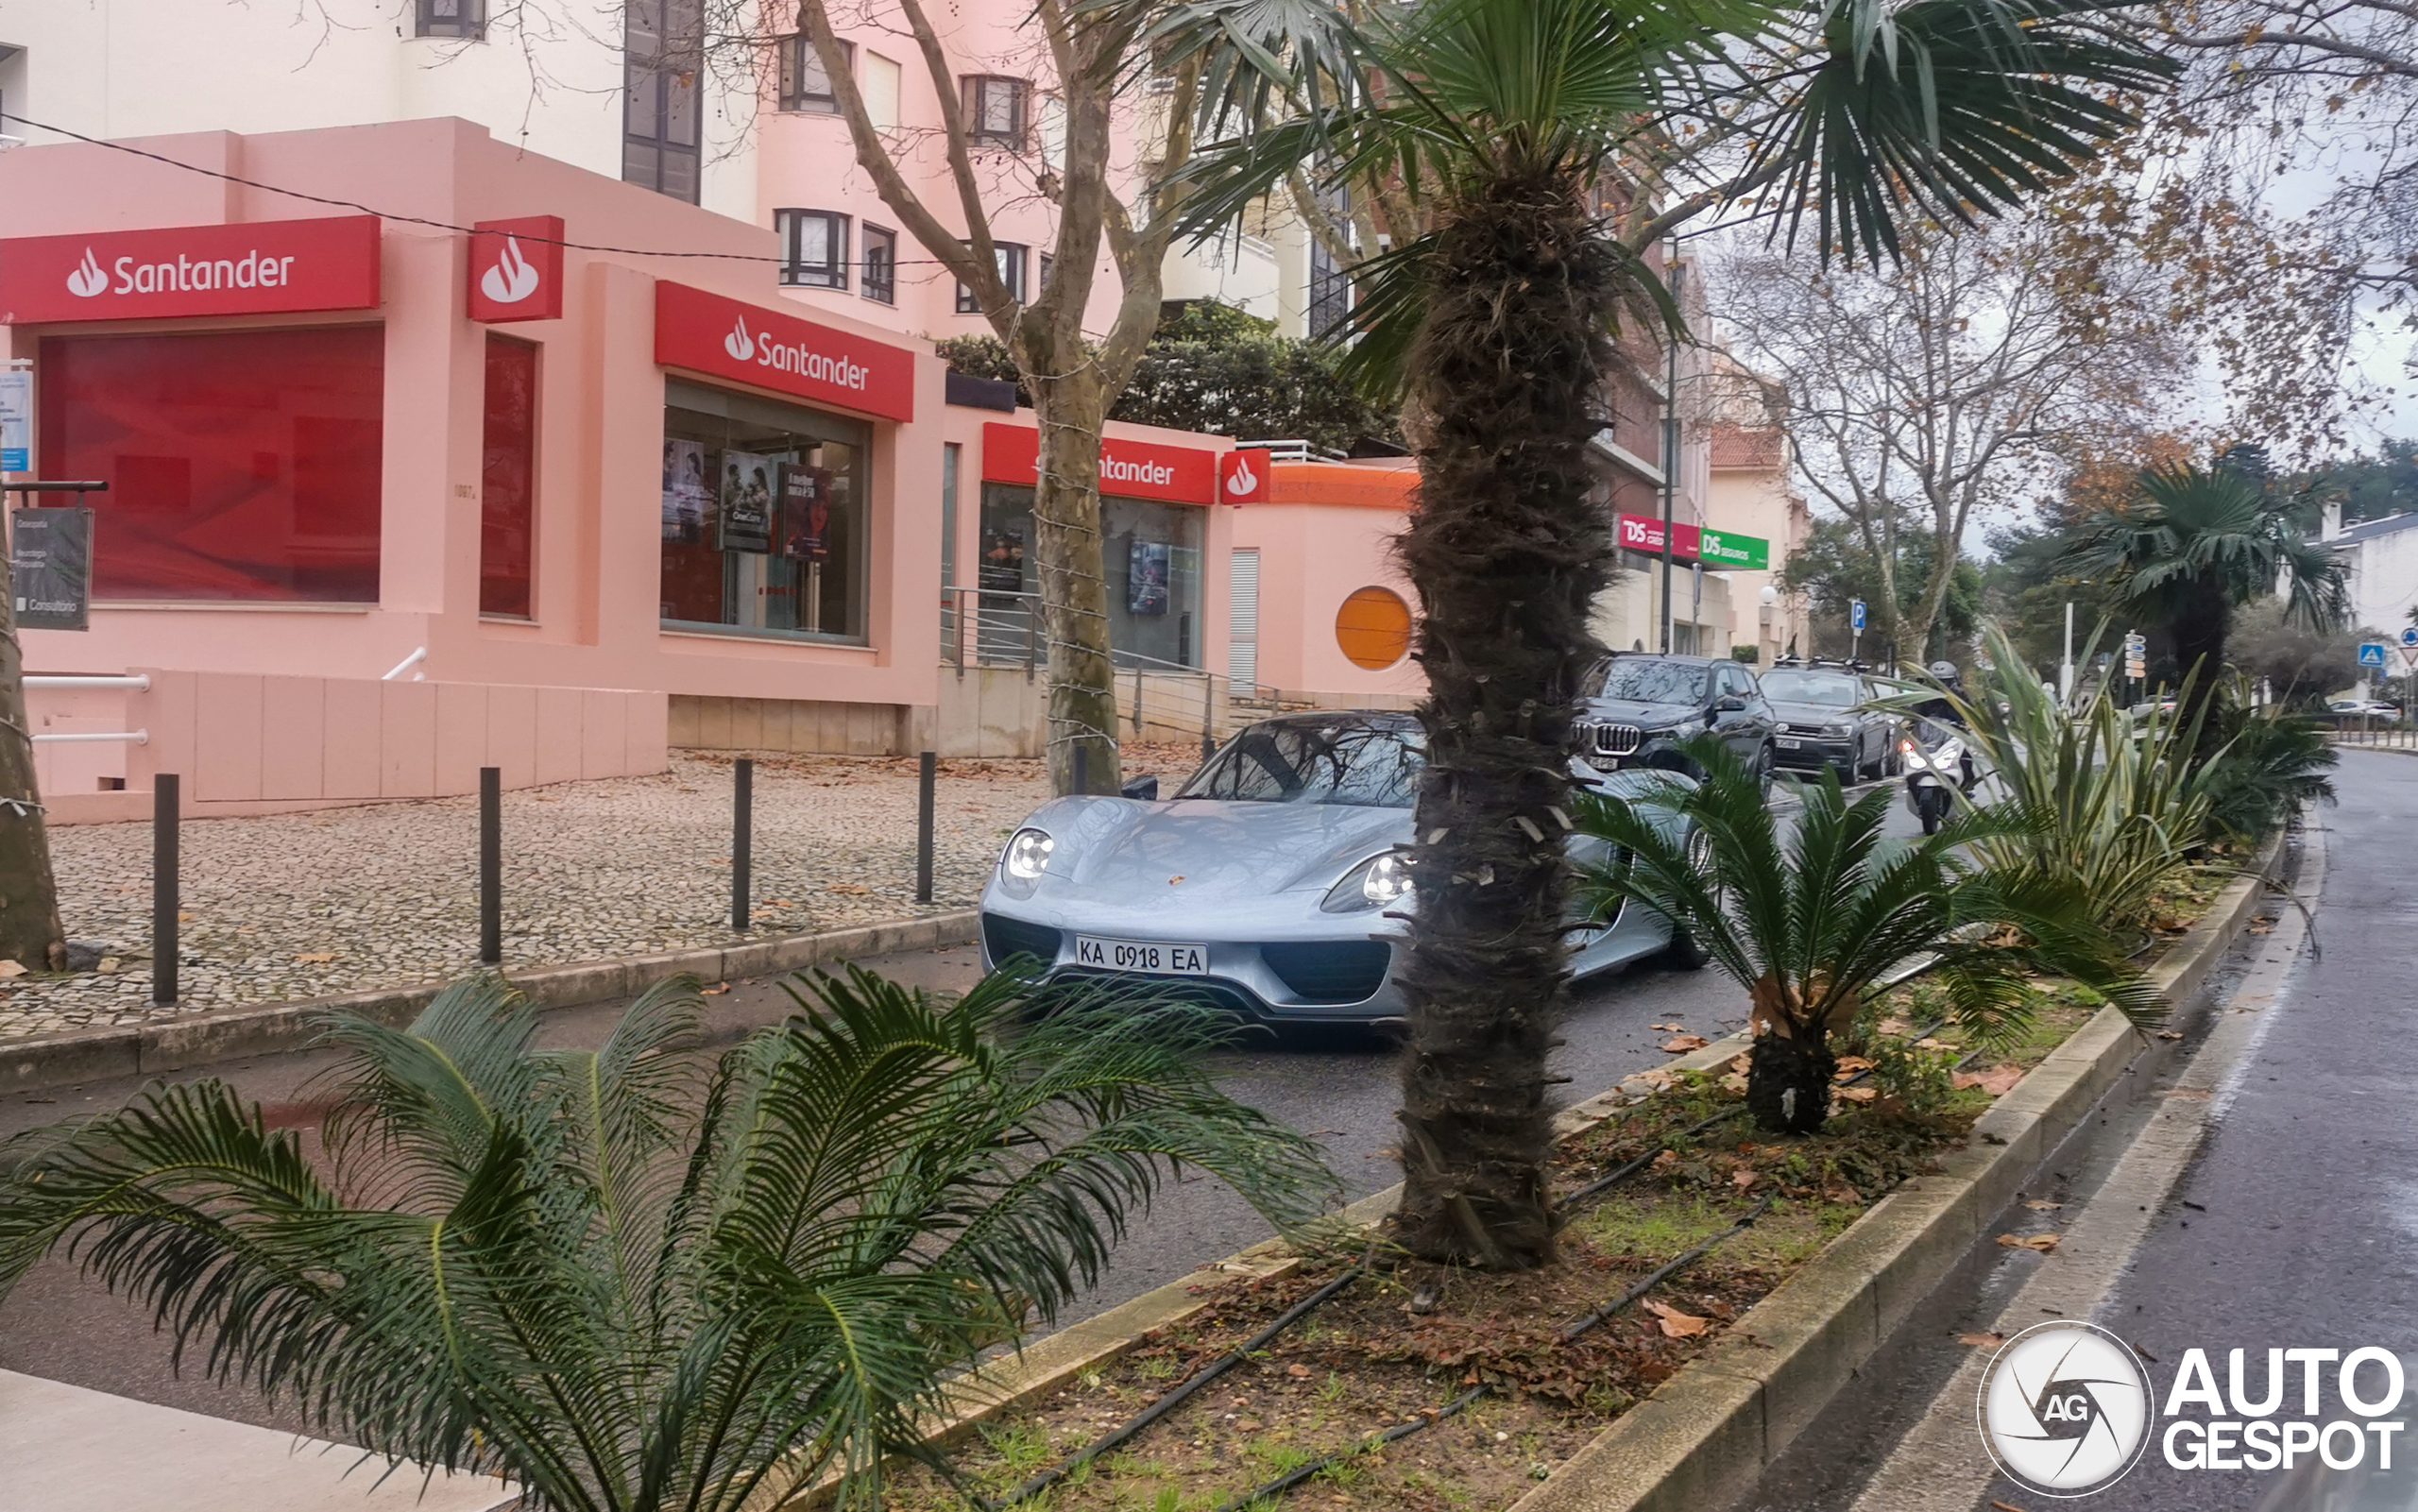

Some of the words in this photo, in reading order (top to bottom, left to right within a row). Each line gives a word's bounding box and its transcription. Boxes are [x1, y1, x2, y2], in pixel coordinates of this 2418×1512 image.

[114, 249, 295, 295] Santander
[758, 331, 869, 390] Santander
[1098, 454, 1175, 485] ntander
[1624, 520, 1646, 543] DS
[1702, 534, 1721, 556] DS
[1855, 604, 1865, 625] P
[1080, 941, 1105, 964] KA
[1115, 945, 1160, 969] 0918
[1171, 948, 1201, 971] EA
